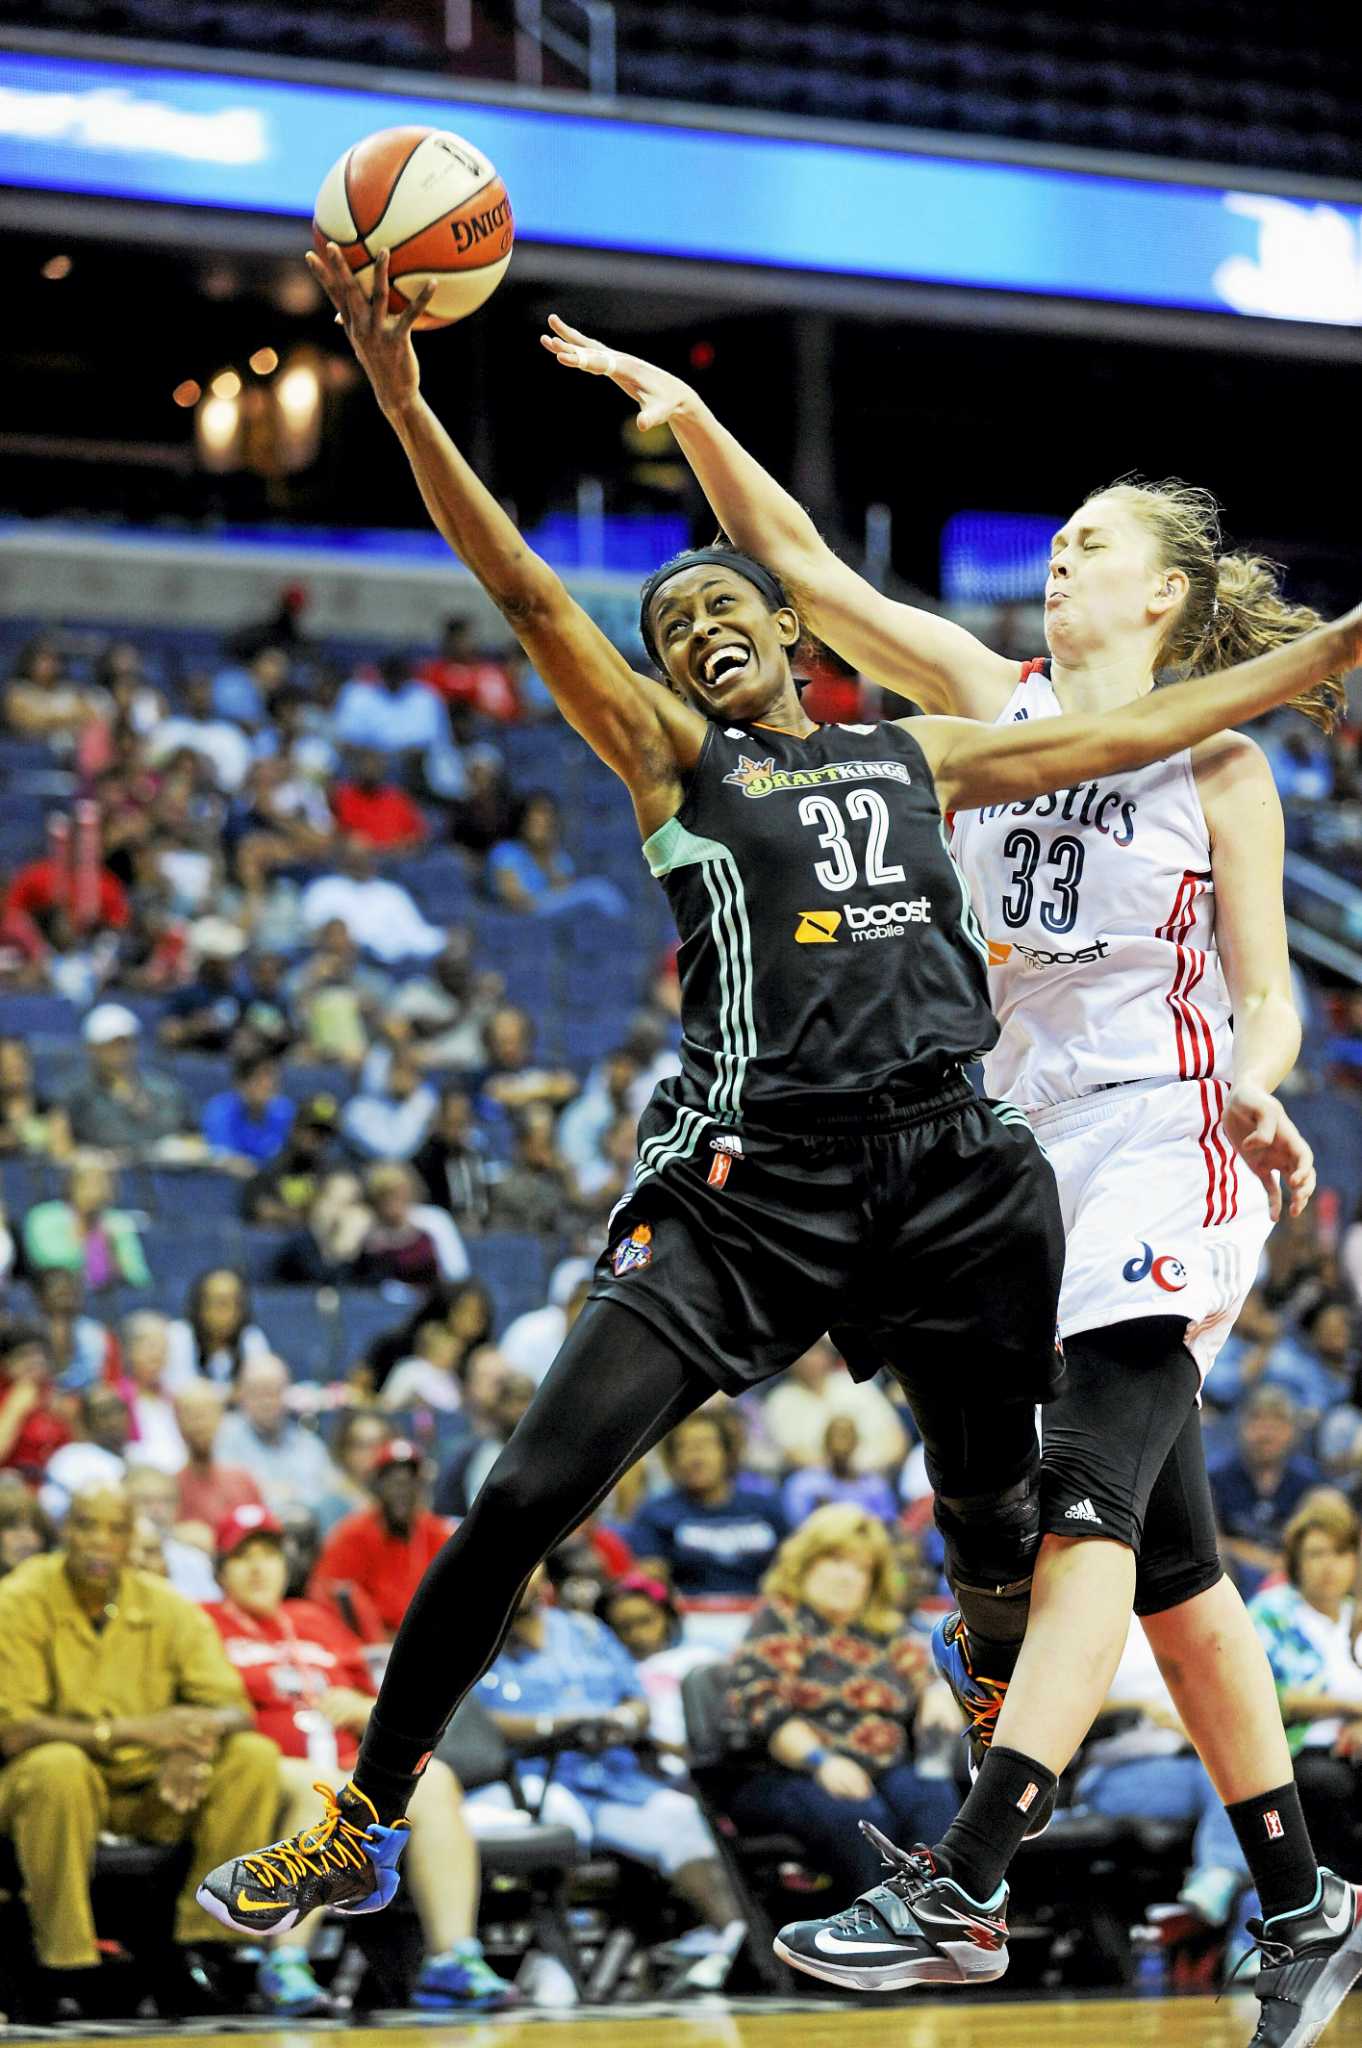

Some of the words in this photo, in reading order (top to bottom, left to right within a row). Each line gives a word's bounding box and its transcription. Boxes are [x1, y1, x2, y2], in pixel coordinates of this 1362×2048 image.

[451, 197, 511, 254] LDING
[798, 788, 906, 891] 32
[1002, 829, 1085, 934] 33
[843, 896, 931, 929] boost
[851, 925, 904, 943] mobile
